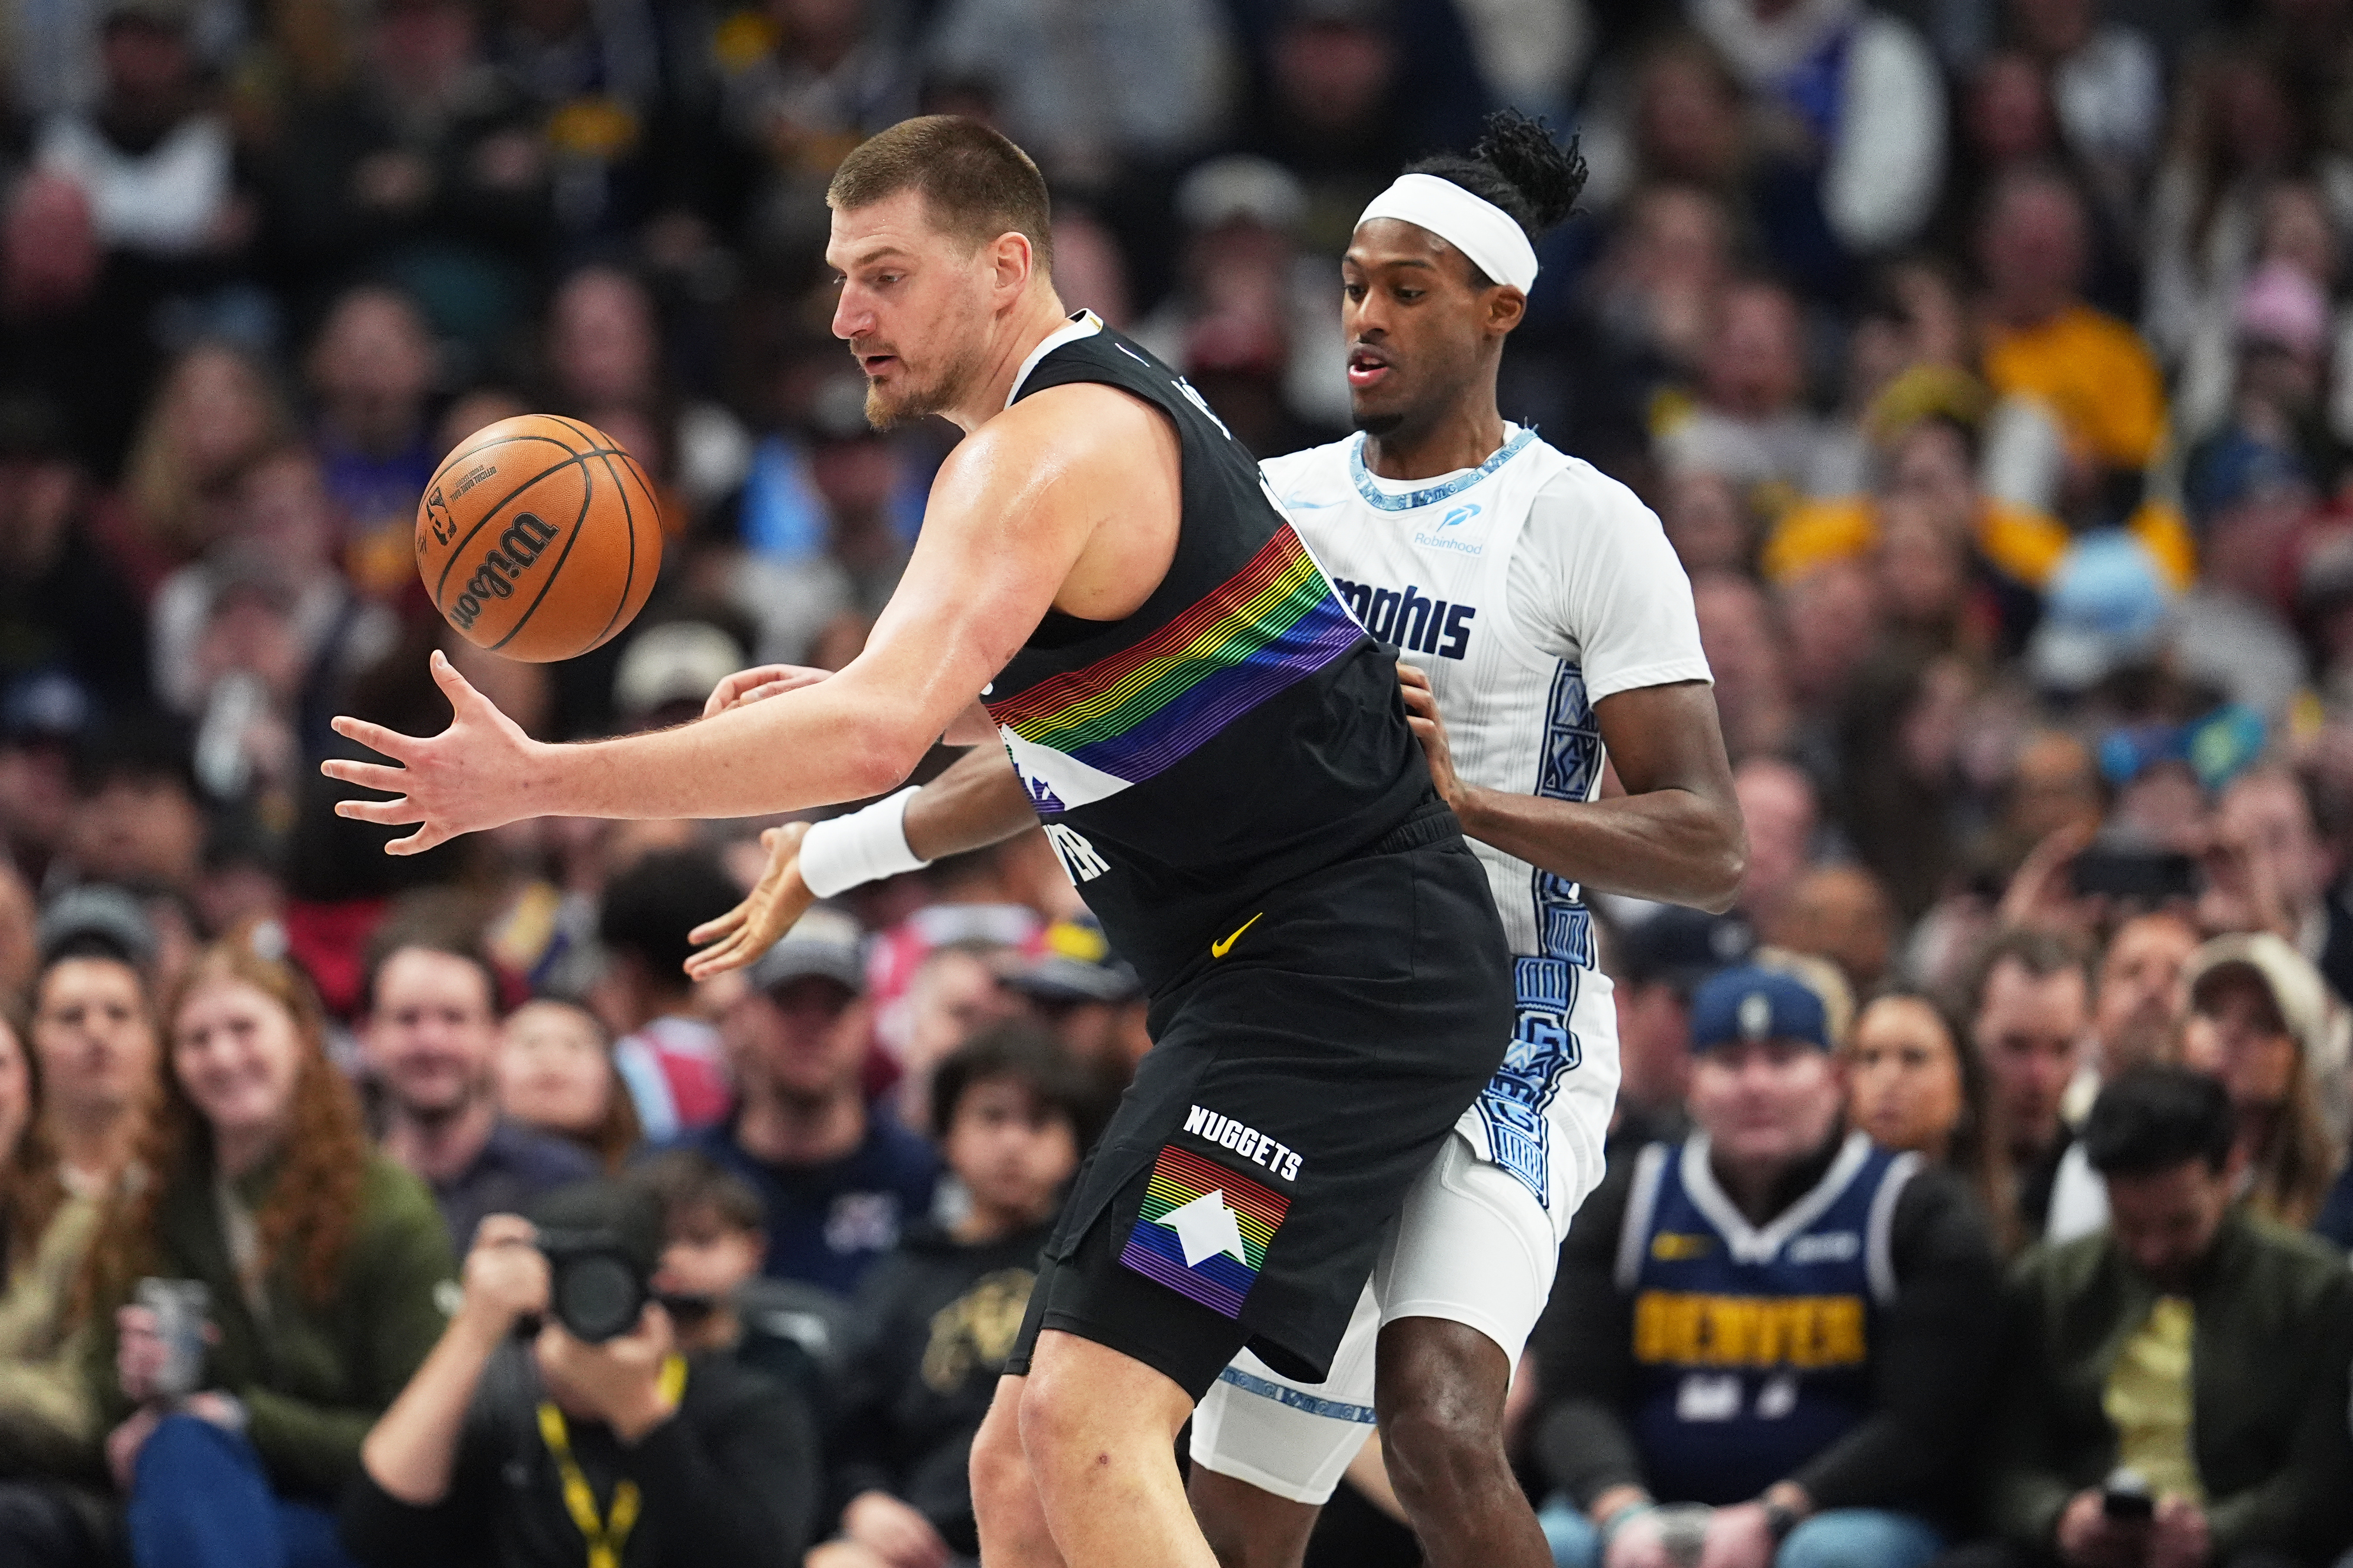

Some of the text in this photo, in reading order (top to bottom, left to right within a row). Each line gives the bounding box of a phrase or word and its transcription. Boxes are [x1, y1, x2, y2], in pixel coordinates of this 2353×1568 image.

[472, 466, 497, 484] OFFICIAL
[460, 479, 475, 494] GAME
[450, 491, 462, 502] BALL
[1414, 533, 1483, 554] Robinhood
[450, 512, 560, 630] Wilson
[1183, 1105, 1303, 1181] NUGGETS
